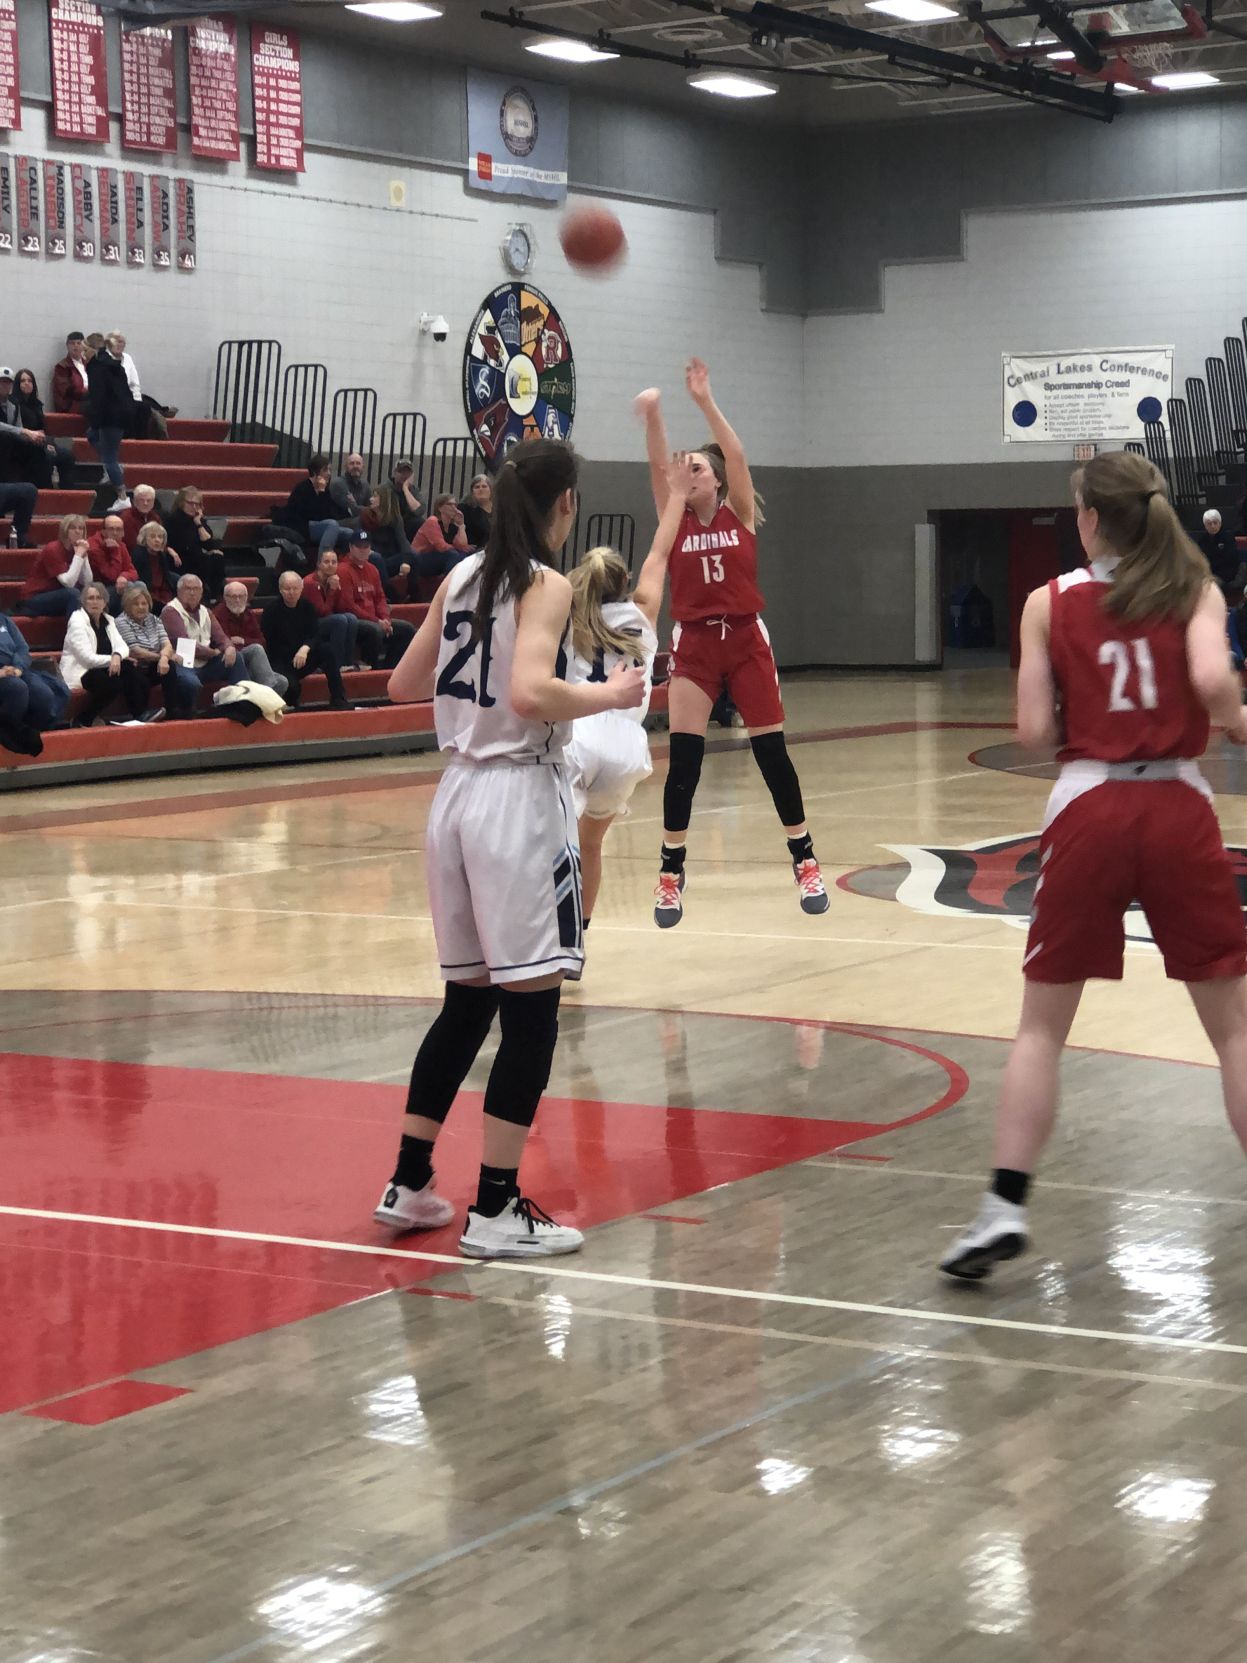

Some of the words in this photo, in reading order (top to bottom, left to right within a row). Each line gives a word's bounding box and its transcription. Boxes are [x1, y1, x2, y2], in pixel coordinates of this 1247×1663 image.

[51, 8, 104, 27] CHAMPIONS
[259, 43, 294, 59] SECTION
[264, 32, 288, 47] GIRLS
[253, 54, 300, 73] CHAMPIONS
[0, 167, 10, 215] EMILY
[28, 166, 39, 221] CALLIE
[56, 165, 65, 229] MADISON
[83, 179, 94, 223] ABBY
[110, 184, 119, 226] JAIDA
[135, 186, 144, 230] ELLA
[161, 189, 170, 233] ADIA
[186, 186, 195, 243] ASHLEY
[26, 236, 40, 252] 23
[53, 239, 66, 255] 25
[82, 242, 95, 257] 30
[108, 244, 120, 261] 31
[133, 248, 145, 264] 33
[160, 251, 171, 266] 35
[1007, 367, 1051, 388] Central
[1056, 362, 1094, 376] Lakes
[1099, 359, 1170, 383] Conference
[1043, 380, 1104, 392] Sportsmanship
[1104, 379, 1131, 389] Creed
[699, 554, 725, 585] 13
[436, 610, 498, 708] 21
[1098, 637, 1159, 712] 21
